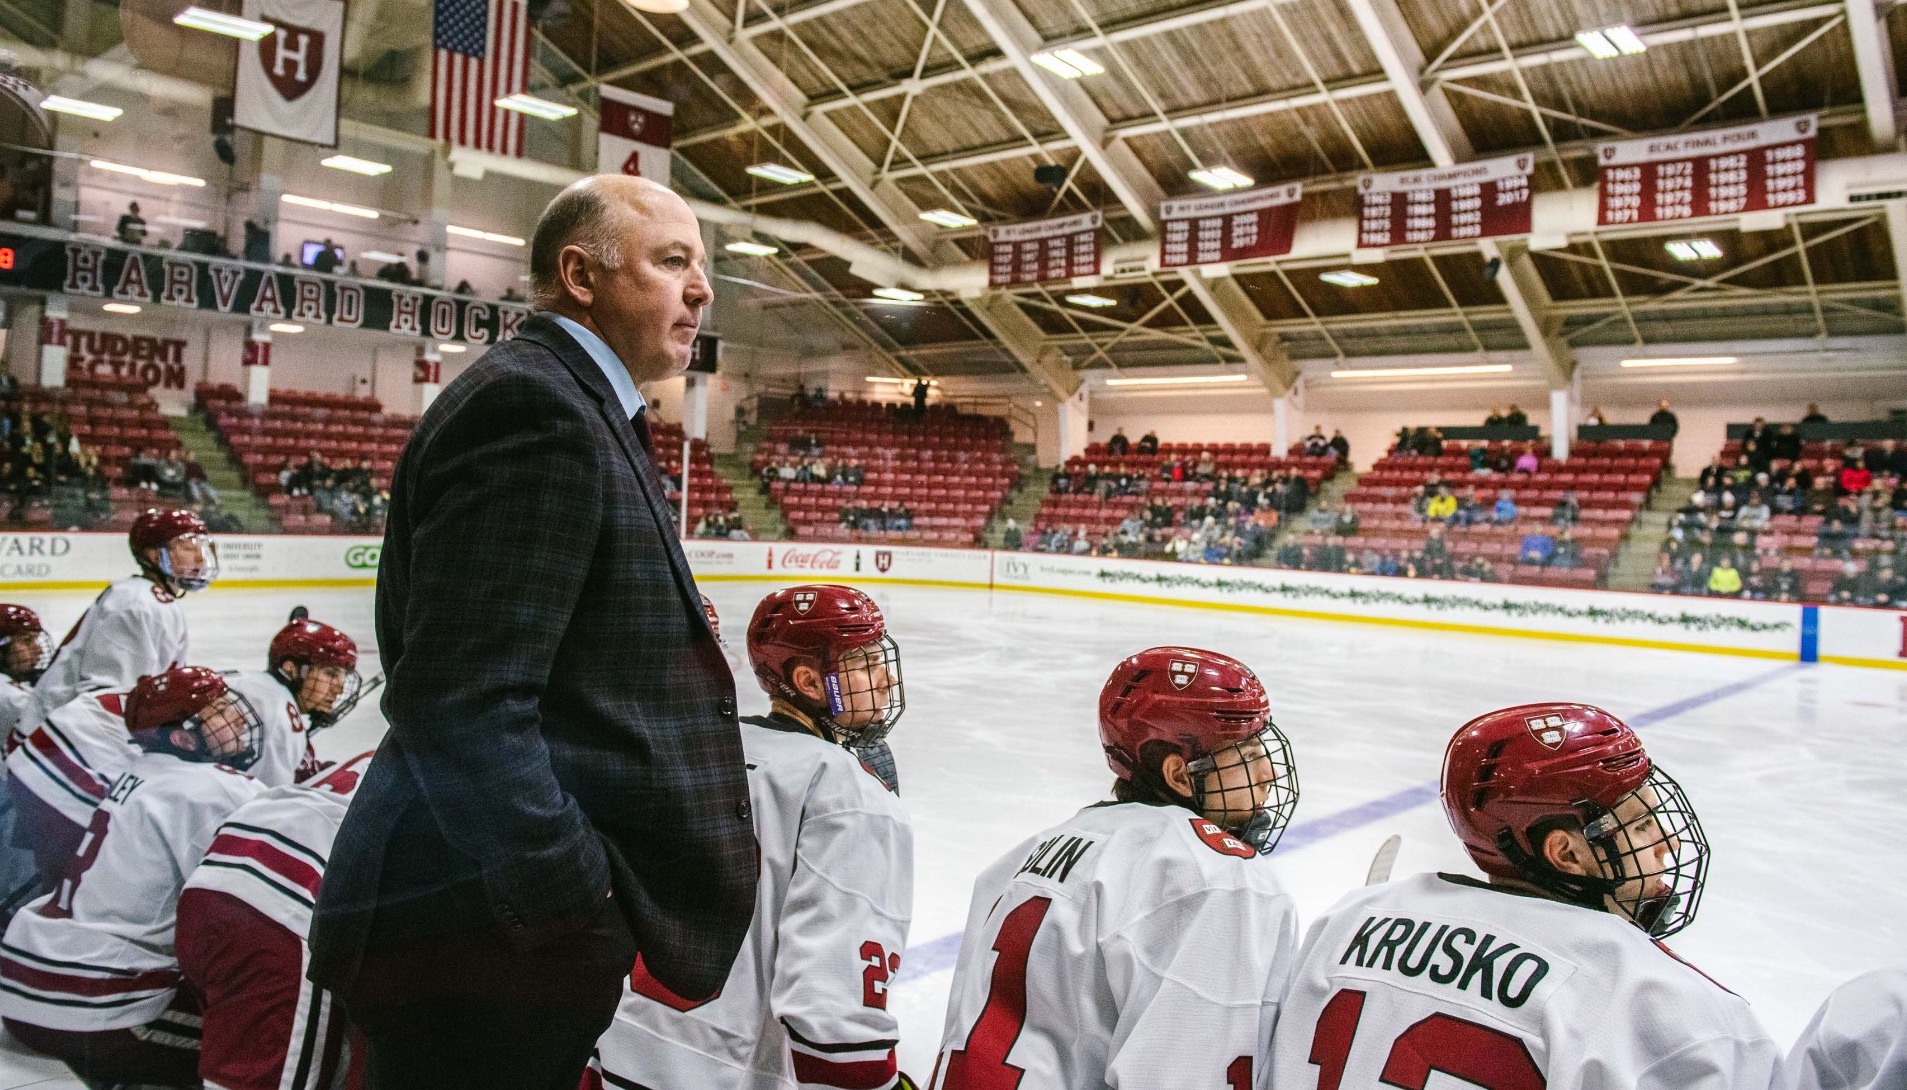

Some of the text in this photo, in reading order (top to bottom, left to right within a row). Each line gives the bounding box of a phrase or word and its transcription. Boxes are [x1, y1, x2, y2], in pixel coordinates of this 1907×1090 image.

[272, 26, 310, 82] H
[1648, 130, 1759, 153] ECAC FINAL FOUR
[1426, 167, 1489, 183] CHAMPIONS
[1496, 188, 1528, 206] 2017
[64, 242, 365, 329] HARVARD
[66, 328, 187, 365] TUDENT
[0, 563, 52, 579] CARD
[781, 548, 844, 570] Coca-Cola
[829, 675, 844, 712] BAUER
[1013, 834, 1095, 883] OLIN
[1339, 916, 1549, 1009] KRUSKO
[928, 895, 1053, 1090] 1
